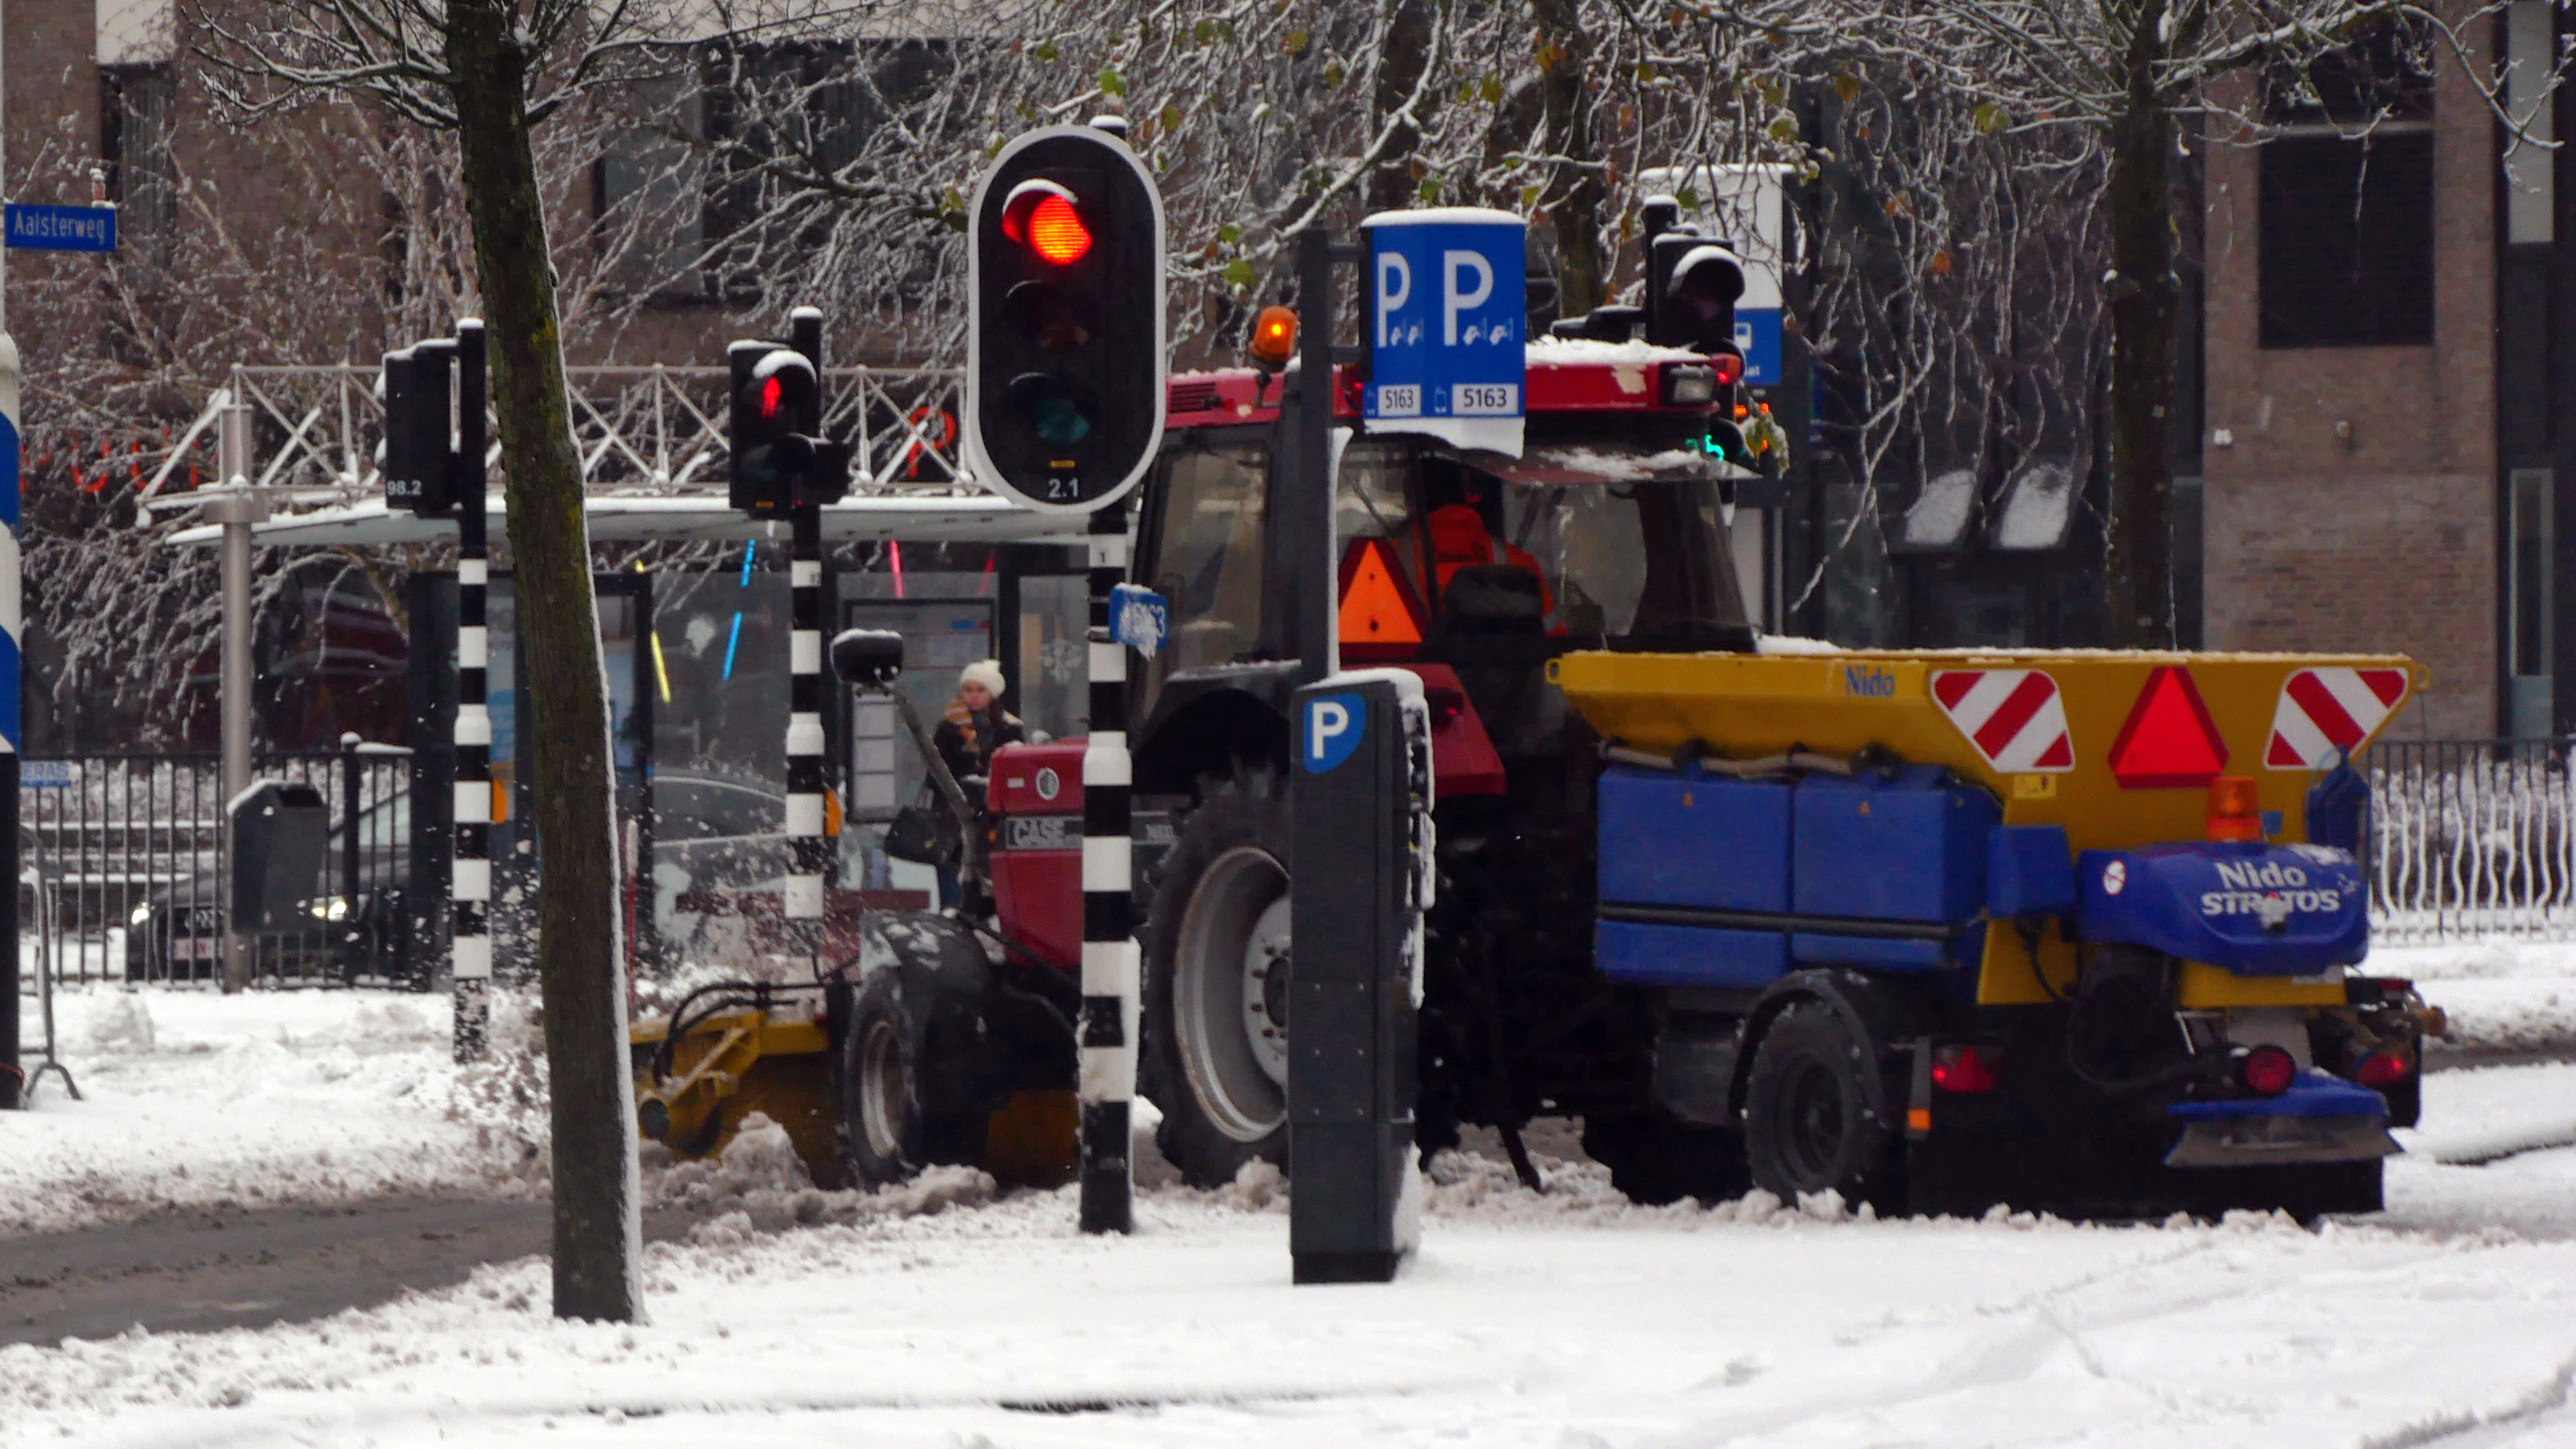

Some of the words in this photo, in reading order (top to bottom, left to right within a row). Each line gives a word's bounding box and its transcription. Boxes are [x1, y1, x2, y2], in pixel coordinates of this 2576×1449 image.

[14, 209, 105, 245] Aalsterweg
[1378, 251, 1411, 348] P
[1444, 249, 1494, 346] P
[1386, 389, 1414, 409] 5163
[1463, 388, 1507, 407] 5163
[387, 478, 422, 496] 98.2
[1048, 478, 1078, 498] 2.1
[1845, 665, 1895, 698] Nido
[1312, 702, 1349, 759] P
[1014, 818, 1065, 846] CASE
[2214, 861, 2308, 889] Nido
